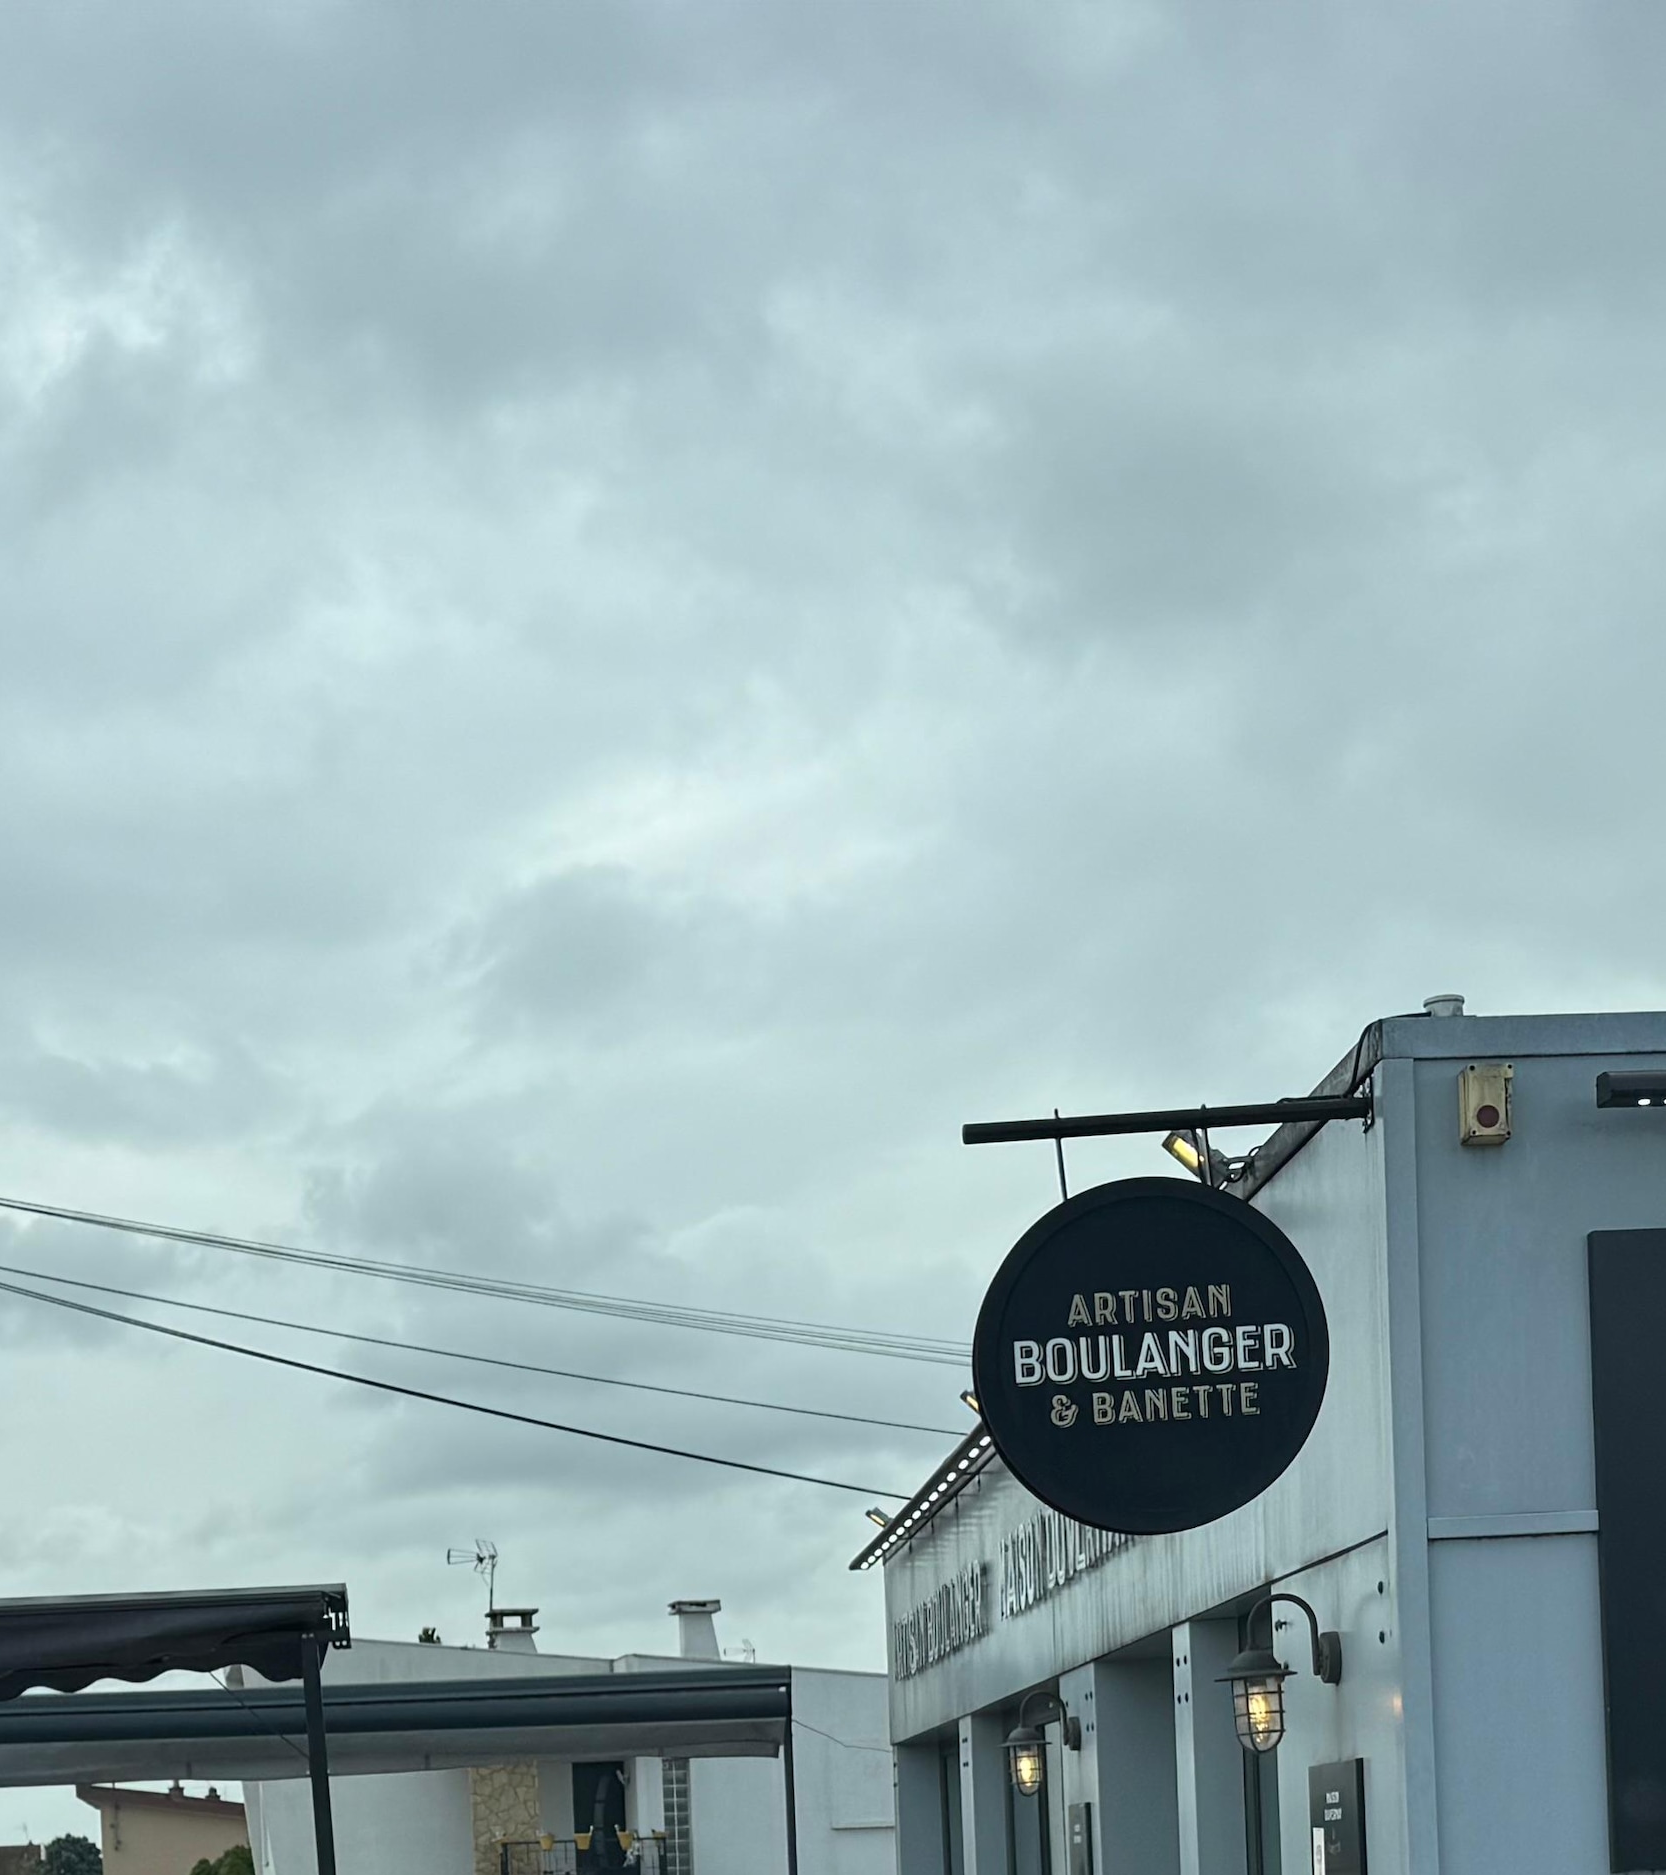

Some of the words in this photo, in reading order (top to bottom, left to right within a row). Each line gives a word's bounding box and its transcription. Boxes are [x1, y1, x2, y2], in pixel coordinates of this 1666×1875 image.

[1068, 1284, 1232, 1327] ARTISAN
[1013, 1323, 1297, 1387] BOULANGER
[1050, 1394, 1079, 1428] &
[1092, 1382, 1261, 1425] BANETTE
